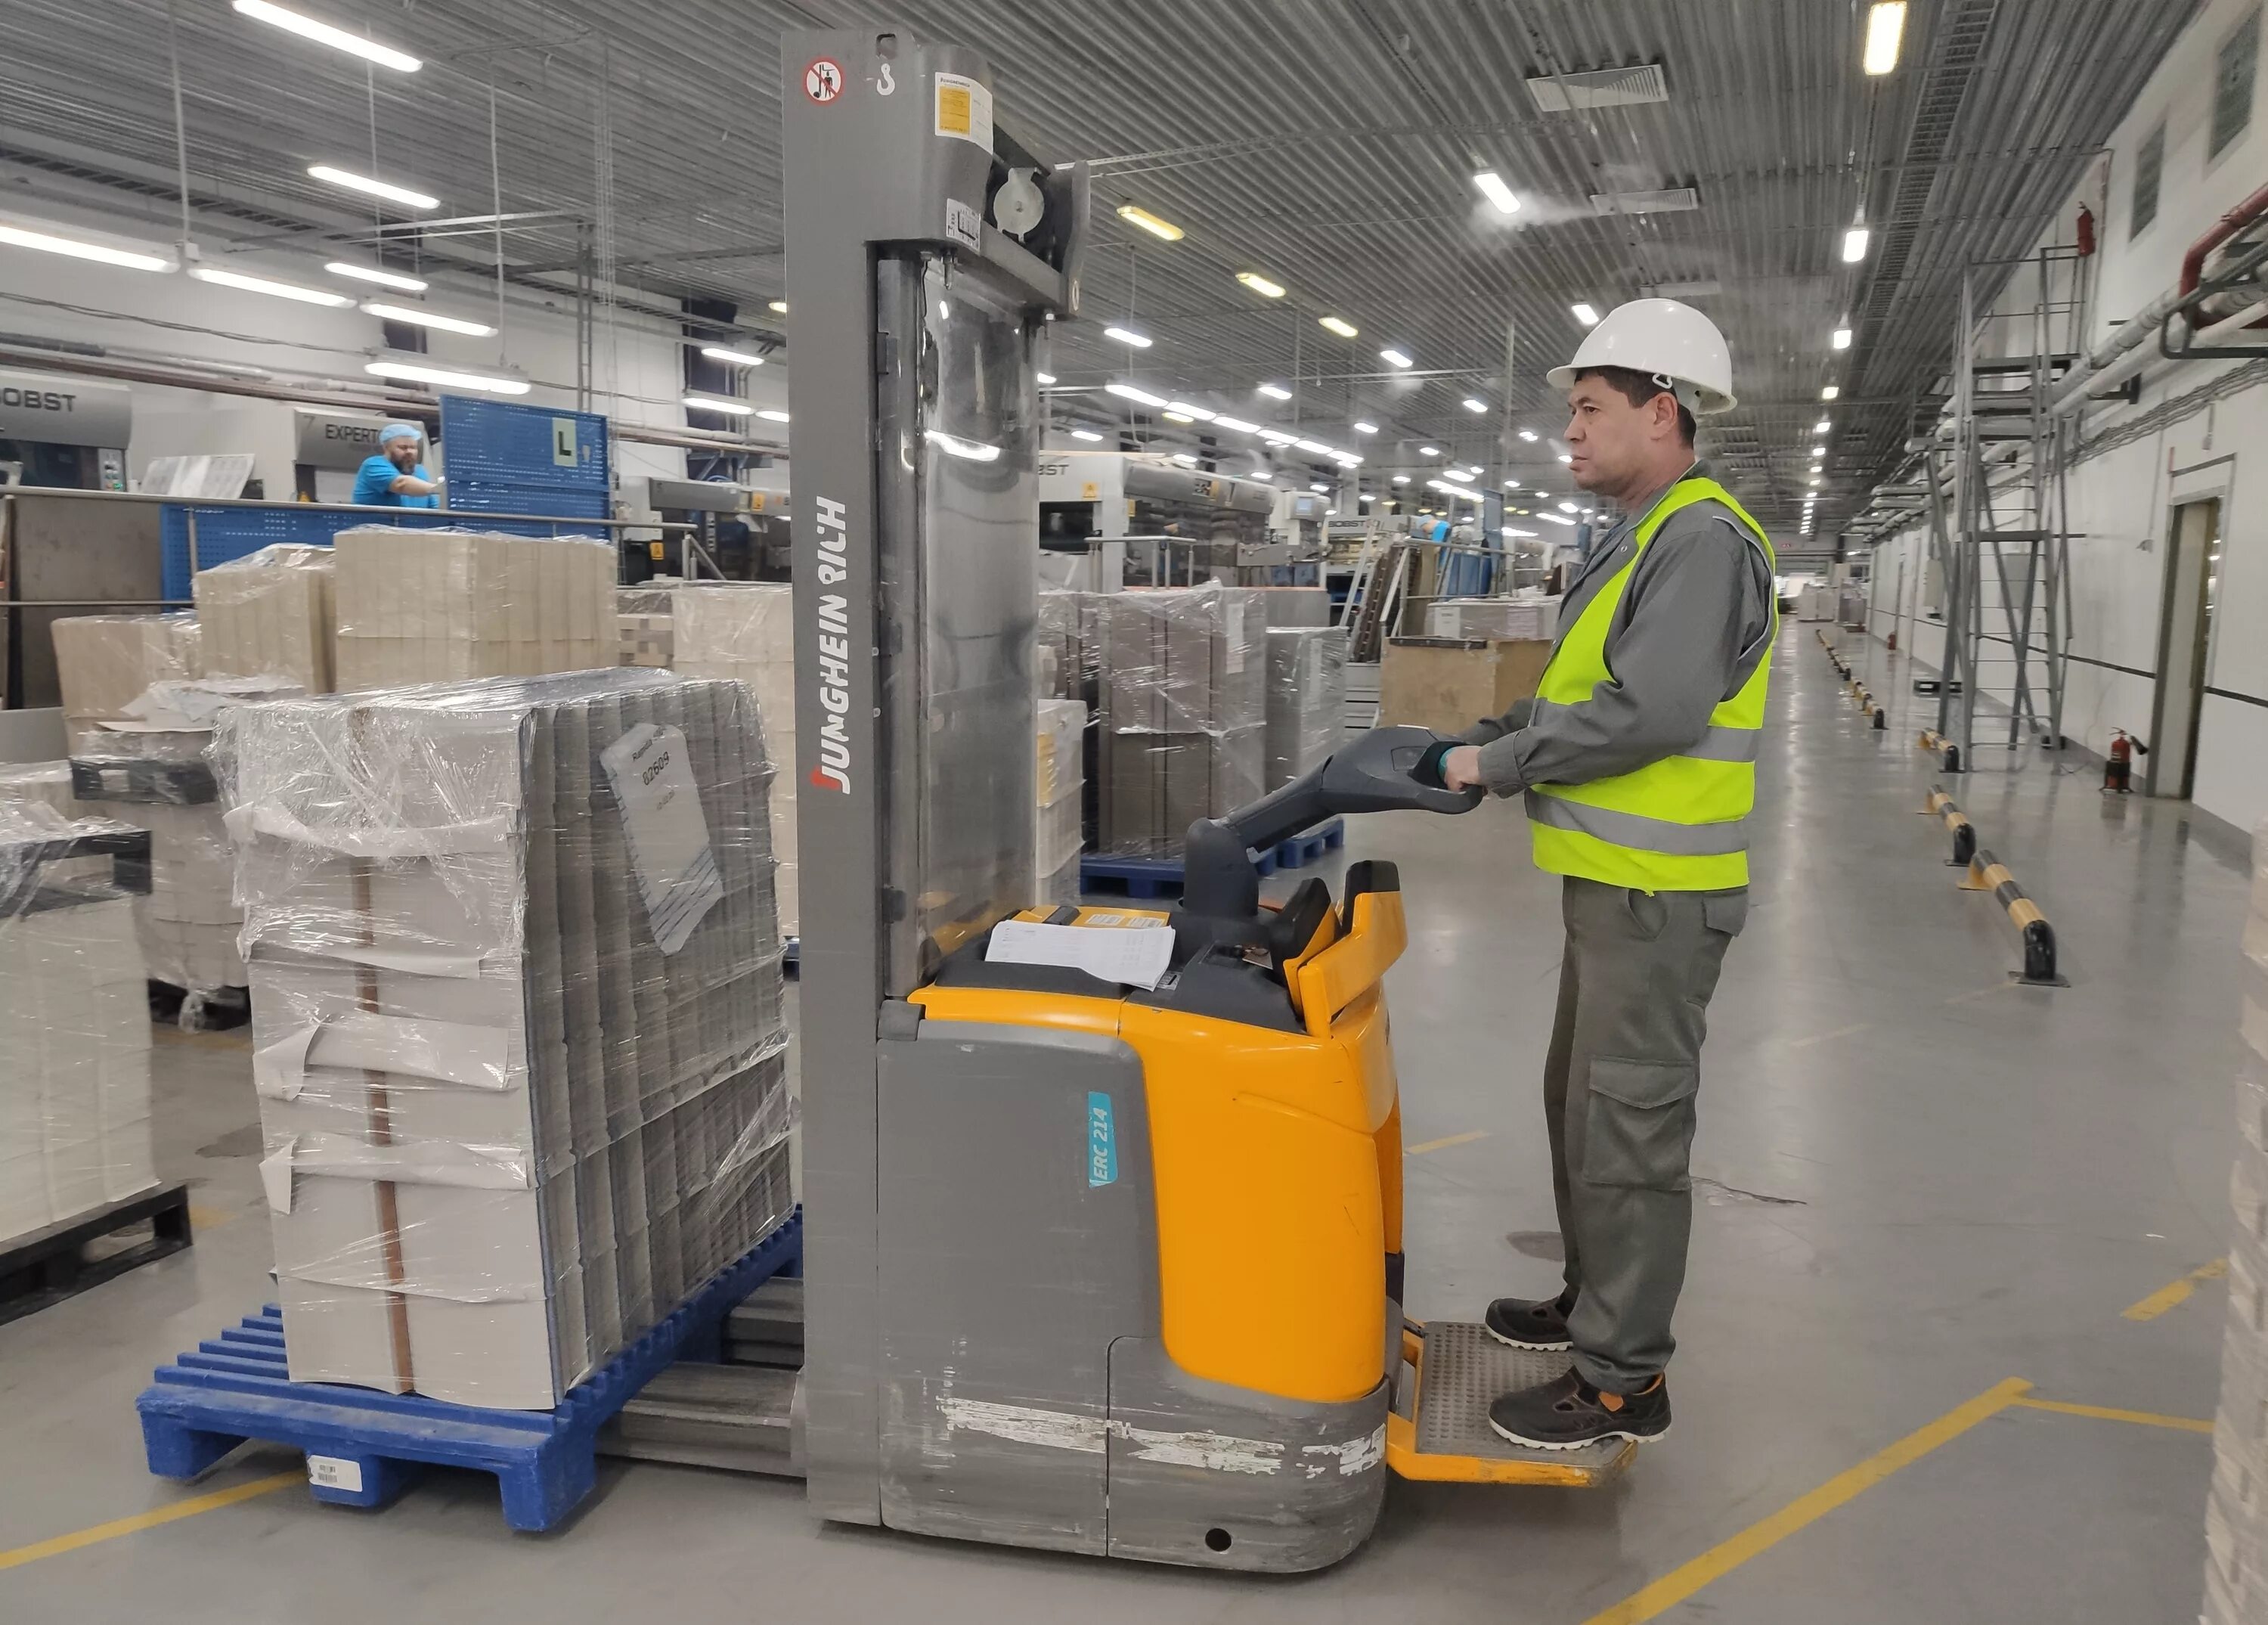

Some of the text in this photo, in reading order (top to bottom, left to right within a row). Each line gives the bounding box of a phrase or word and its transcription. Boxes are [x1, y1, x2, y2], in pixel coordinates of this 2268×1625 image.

[0, 386, 76, 412] OBST
[326, 423, 381, 444] EXPERT
[558, 430, 572, 457] L
[1328, 519, 1365, 528] BOBST
[642, 751, 670, 786] 82609
[1092, 1107, 1108, 1180] ERC 214
